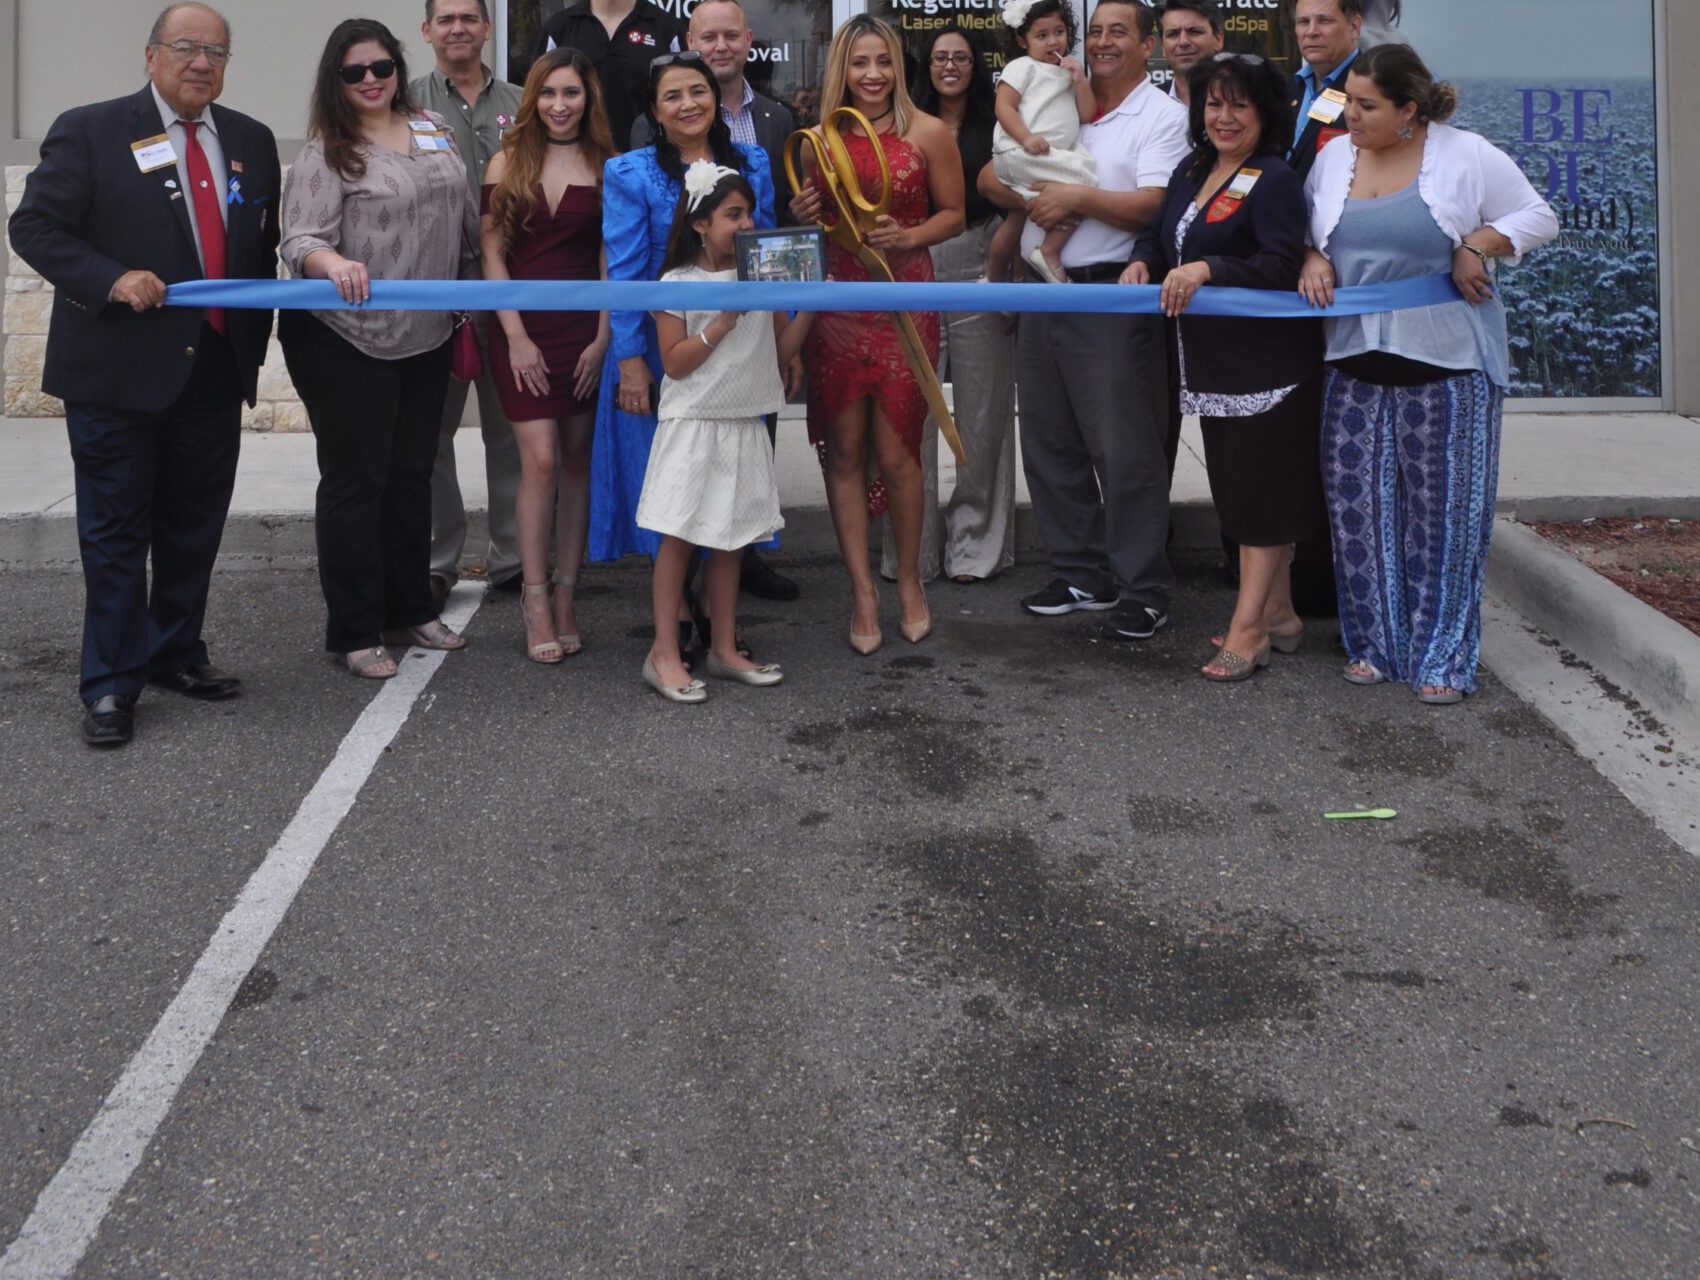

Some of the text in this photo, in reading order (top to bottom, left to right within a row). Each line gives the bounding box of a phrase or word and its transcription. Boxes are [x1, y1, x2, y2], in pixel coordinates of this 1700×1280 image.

[1224, 16, 1269, 35] dSpa
[746, 43, 789, 62] oval
[1515, 89, 1613, 144] BE
[1508, 151, 1612, 208] OU
